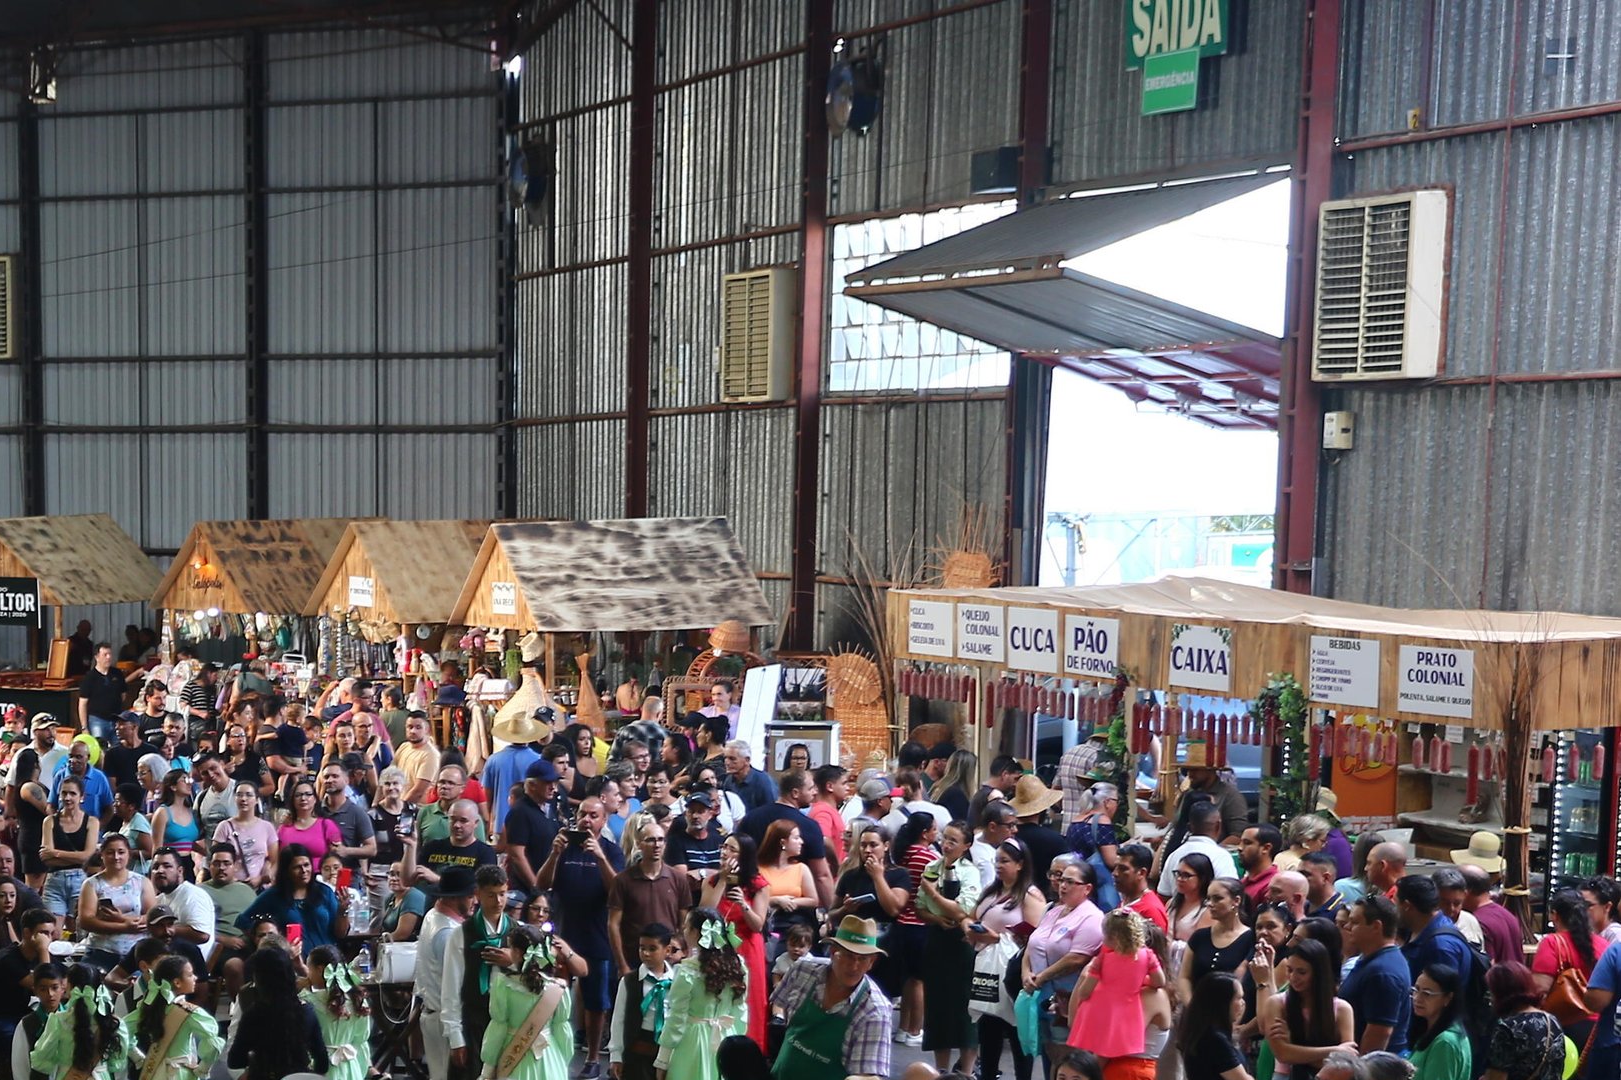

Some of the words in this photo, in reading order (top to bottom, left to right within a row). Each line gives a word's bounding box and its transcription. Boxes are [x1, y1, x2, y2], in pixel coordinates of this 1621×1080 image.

[1144, 70, 1195, 91] EMERGÊNCIA
[912, 607, 925, 615] CUCA
[965, 610, 990, 621] QUEIJO
[965, 623, 999, 637] COLONIAL
[1074, 621, 1108, 654] PÃO
[1010, 626, 1055, 653] CUCA
[1329, 639, 1361, 651] BEBIDAS
[965, 642, 992, 655] SALAME
[1067, 655, 1079, 669] DE
[1080, 657, 1114, 673] FORNO
[1172, 645, 1228, 675] CAIXA
[1417, 651, 1457, 668] PRATO
[1407, 668, 1465, 687] COLONIAL
